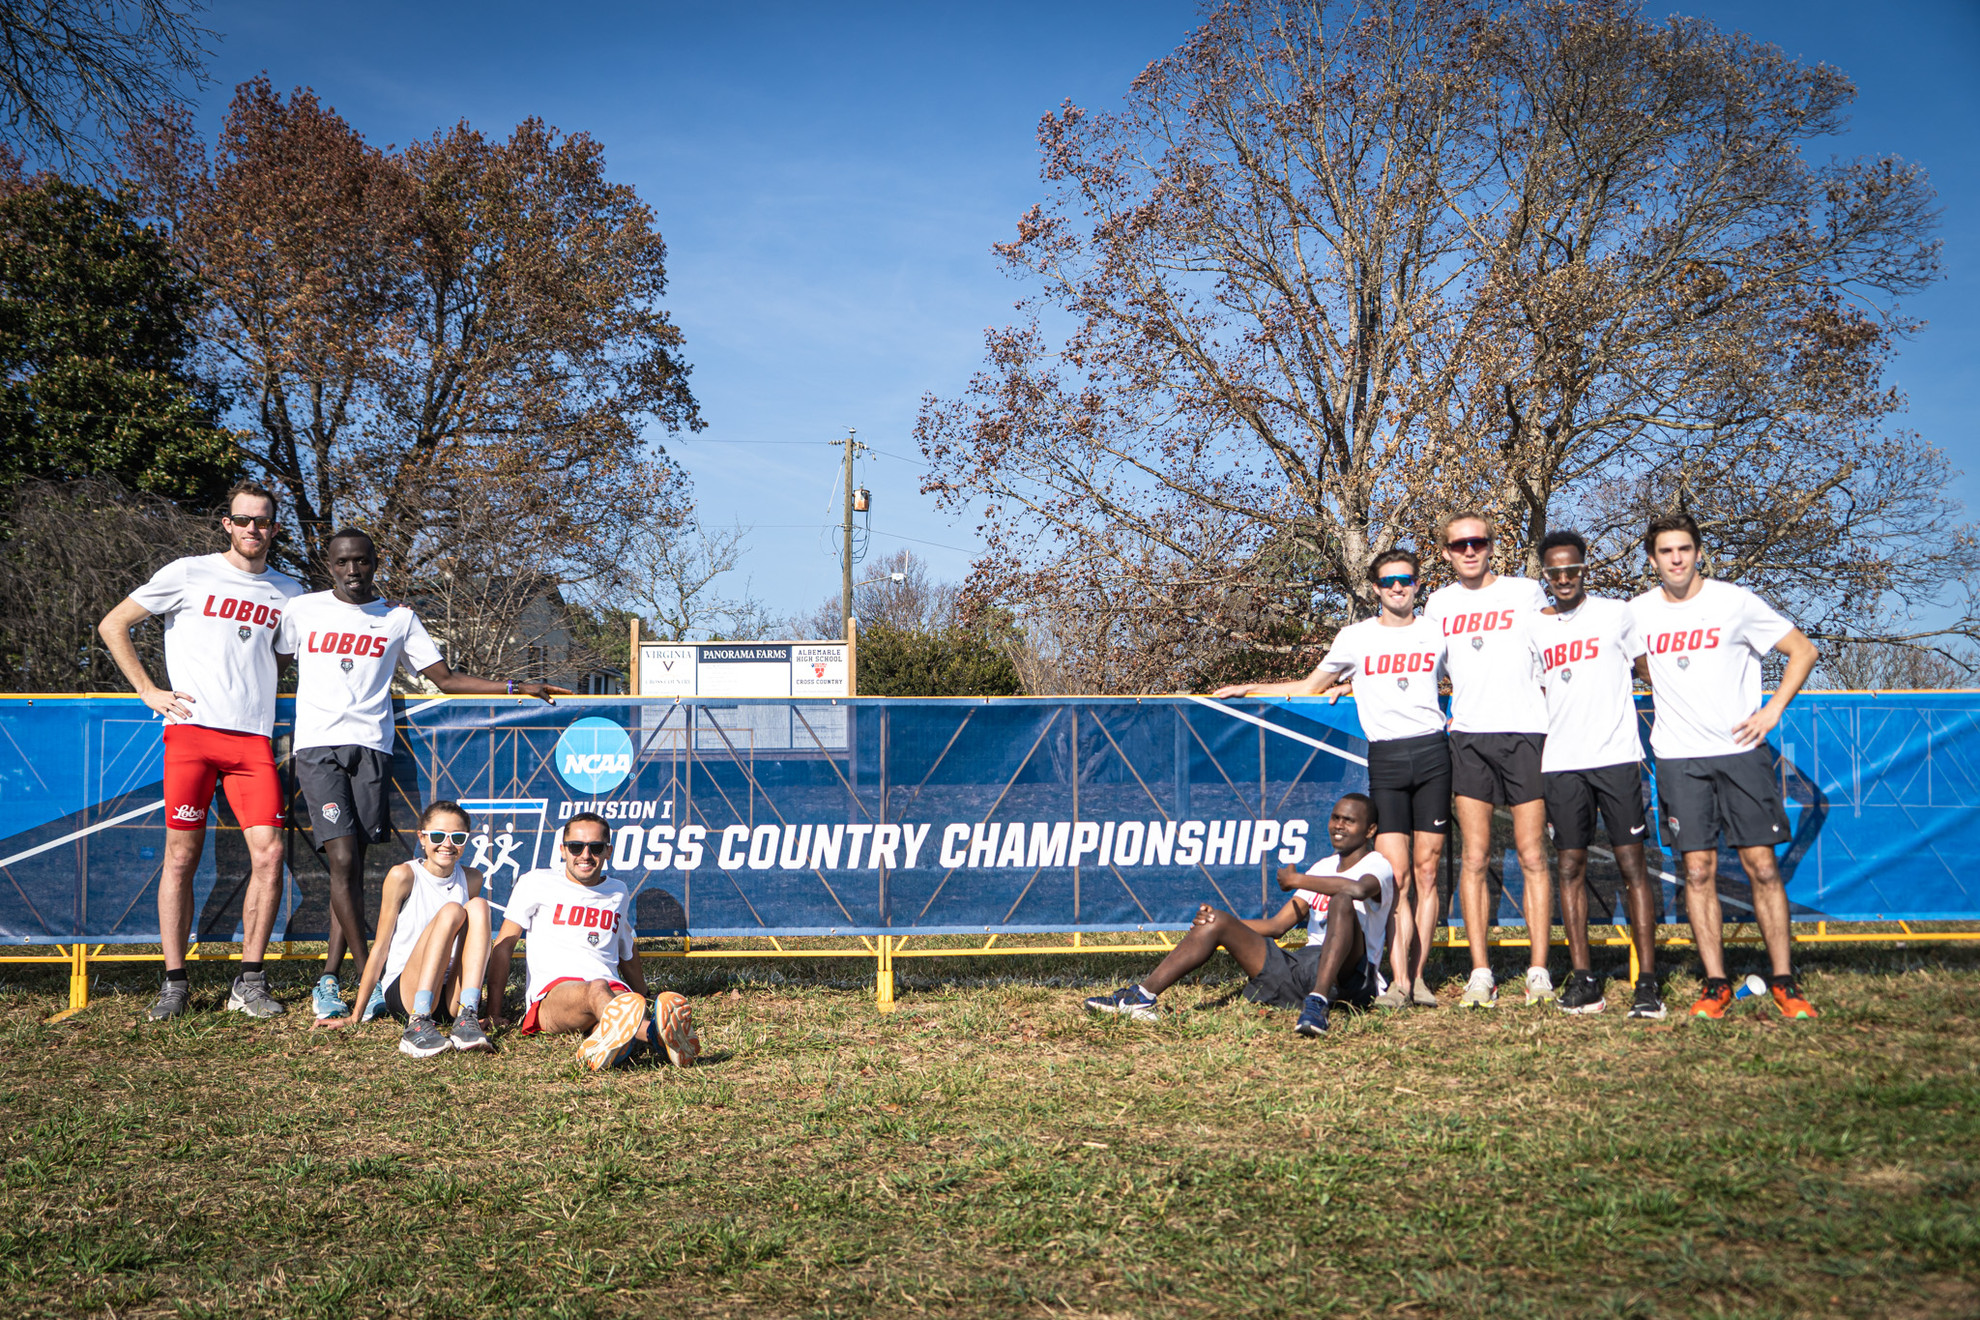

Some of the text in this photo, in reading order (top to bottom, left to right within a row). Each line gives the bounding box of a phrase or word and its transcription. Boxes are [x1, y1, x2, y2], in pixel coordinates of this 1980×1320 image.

[203, 595, 282, 630] LOBOS
[308, 632, 388, 658] LOBOS
[645, 650, 692, 659] VIRGINIA
[703, 649, 787, 659] PANORAMA FARMS
[1543, 637, 1600, 674] OBOS
[1365, 652, 1436, 676] LOBOS
[563, 754, 630, 774] NCAA
[172, 804, 205, 822] Lobos
[558, 801, 673, 819] DIVISION I
[717, 824, 932, 870] COUNTRY
[938, 819, 1310, 869] CHAMPIONSHIPS
[553, 903, 622, 934] LOBOS
